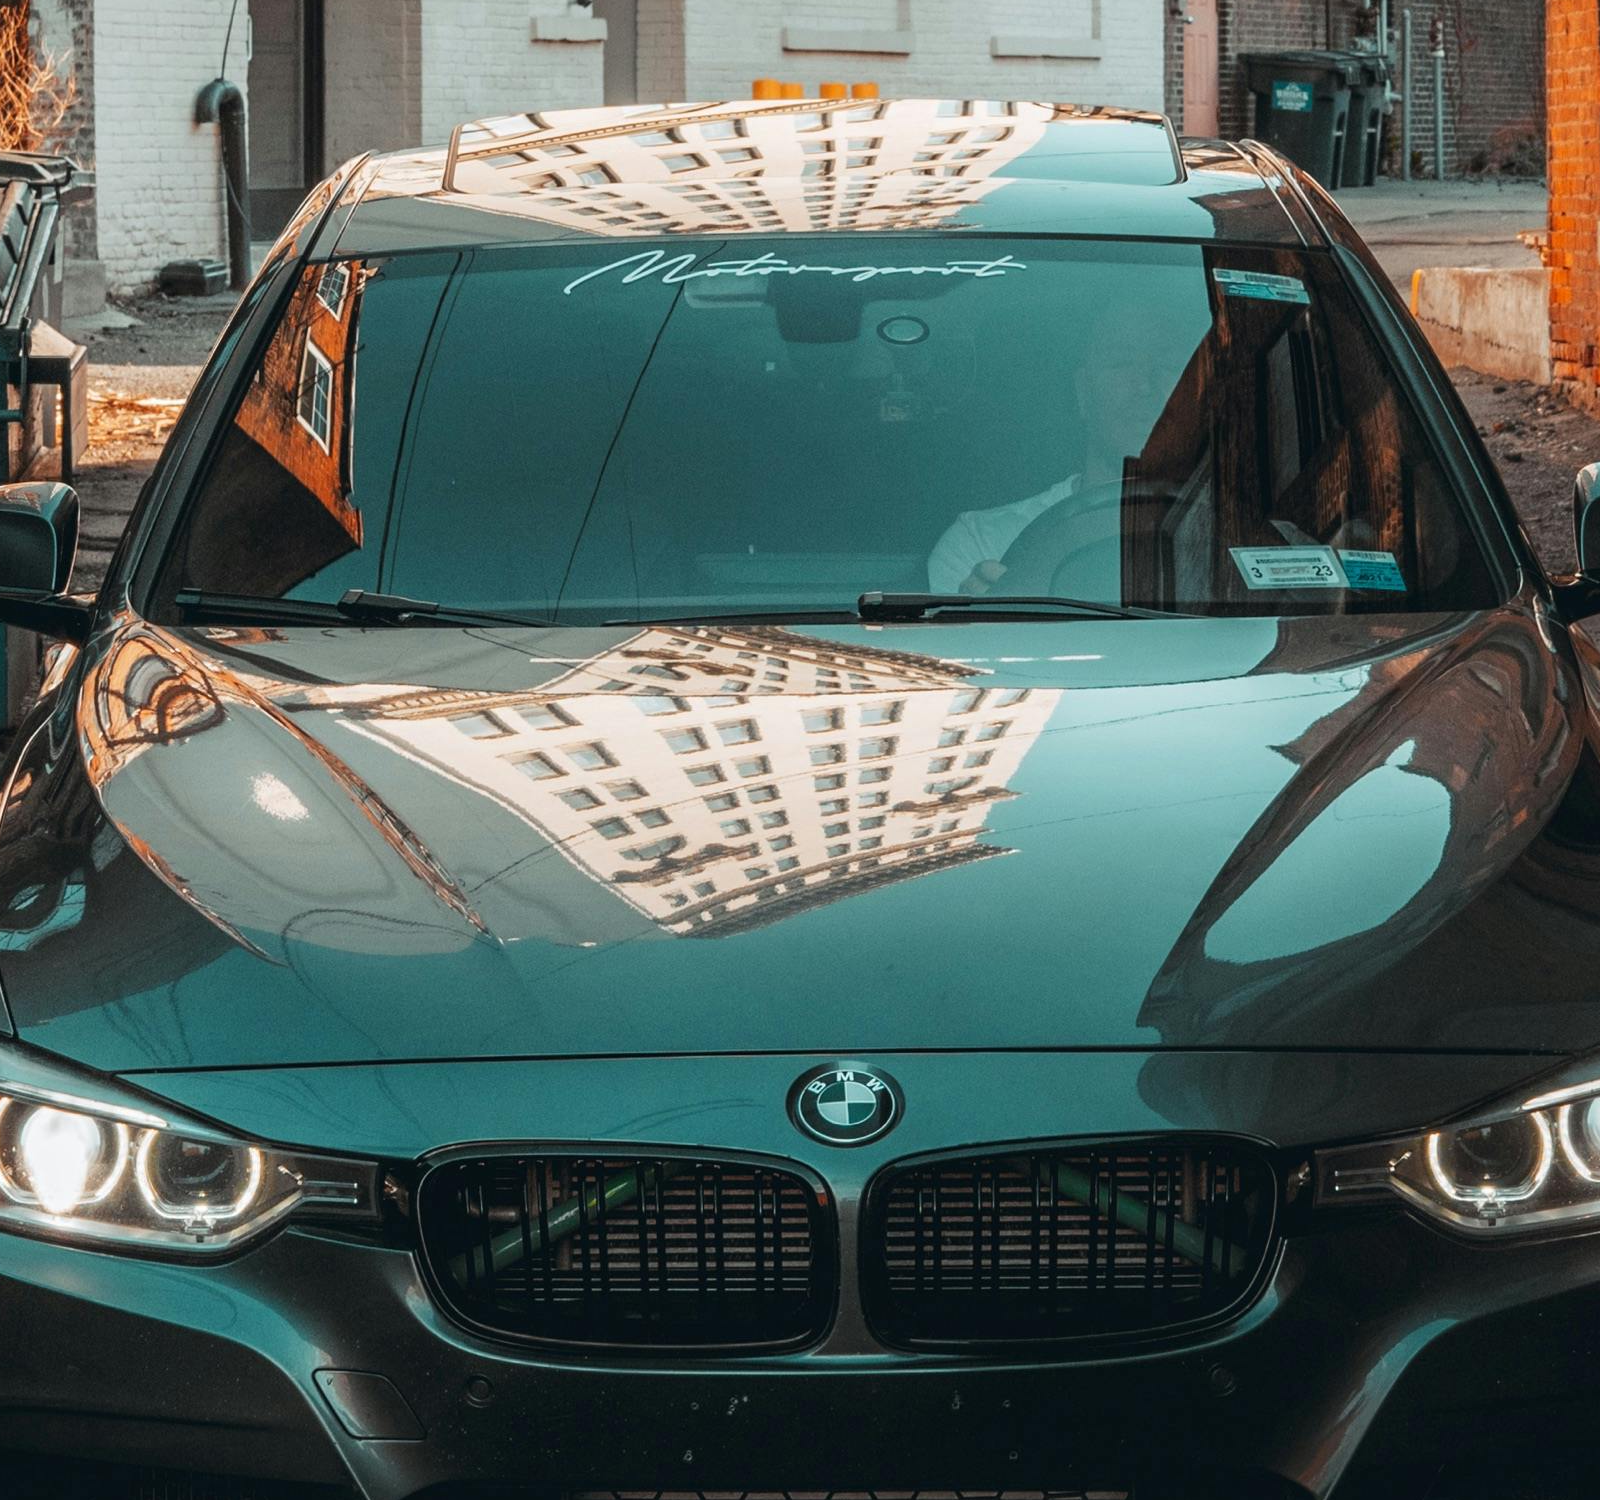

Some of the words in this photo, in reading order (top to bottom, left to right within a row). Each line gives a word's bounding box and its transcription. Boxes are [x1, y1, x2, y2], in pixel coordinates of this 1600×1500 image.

[563, 248, 1028, 296] Motorsport
[1312, 565, 1334, 577] 23
[807, 1071, 885, 1095] BMW
